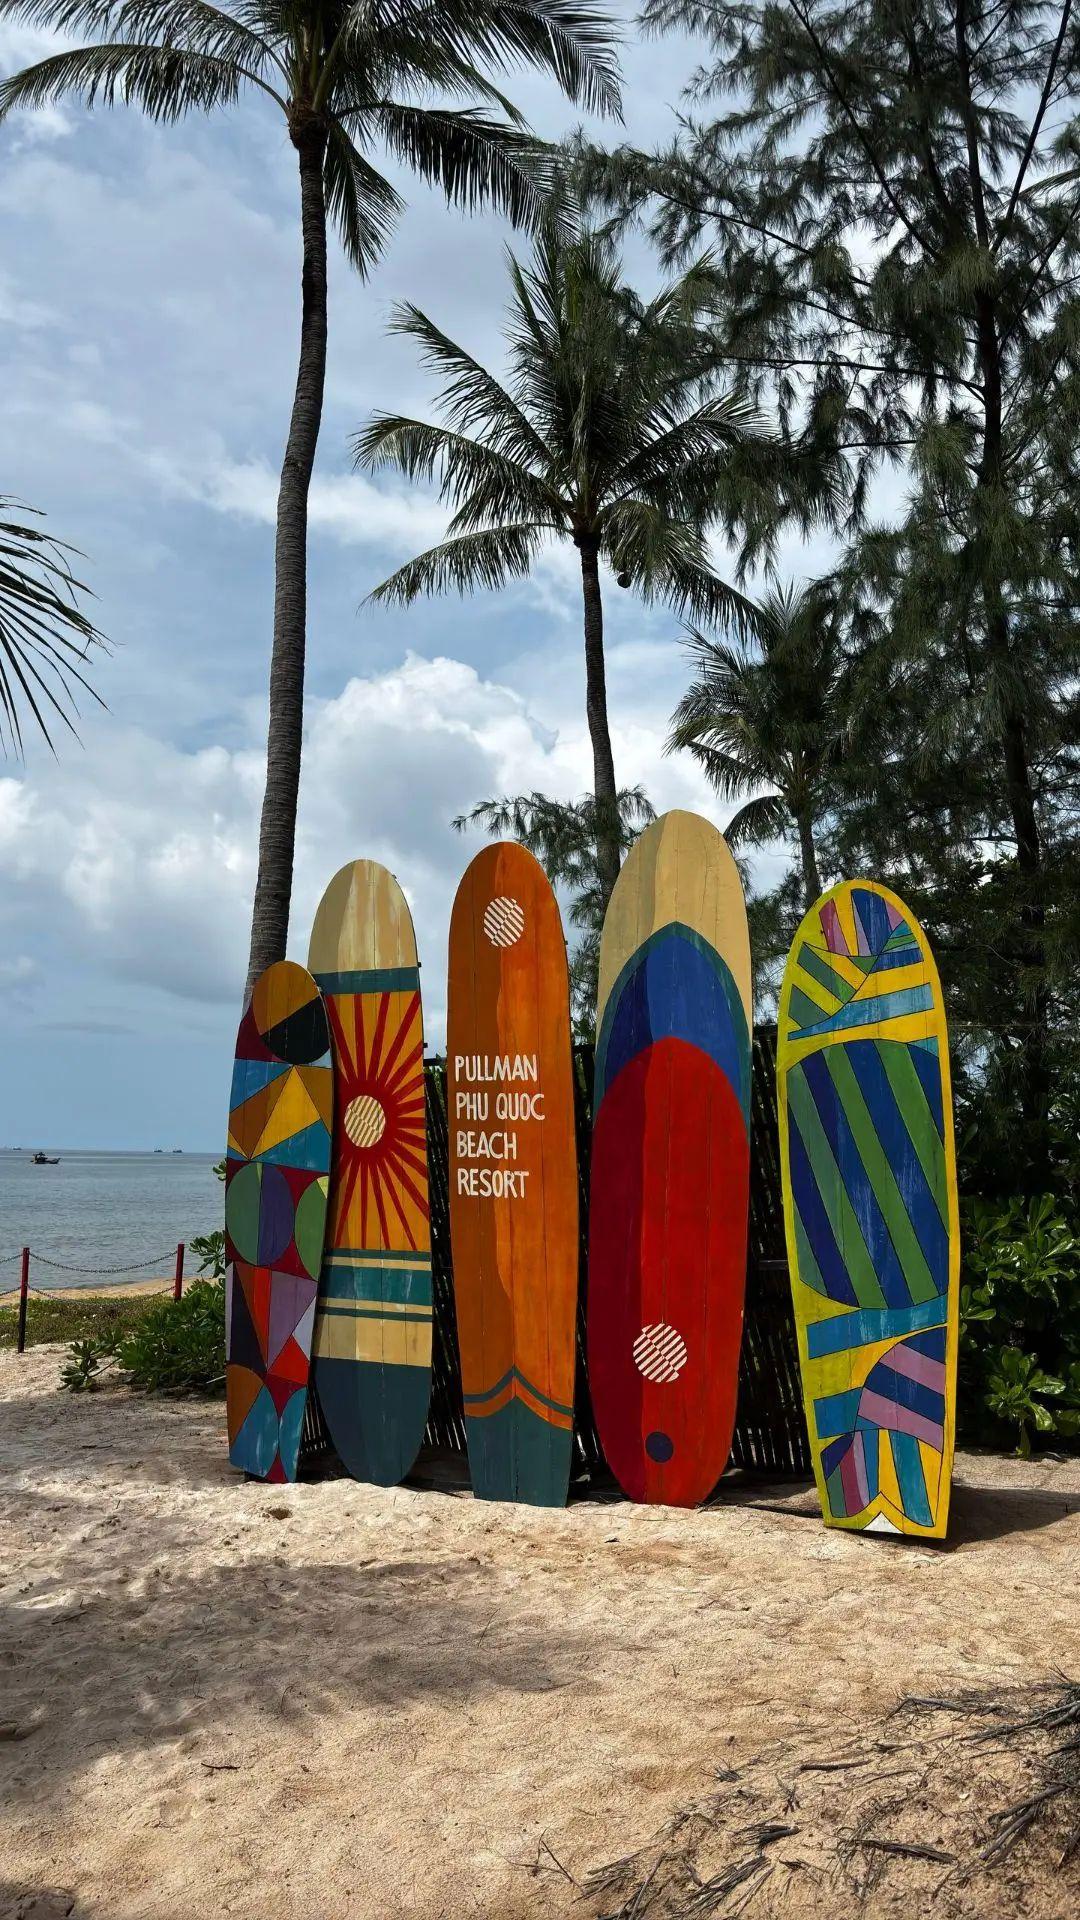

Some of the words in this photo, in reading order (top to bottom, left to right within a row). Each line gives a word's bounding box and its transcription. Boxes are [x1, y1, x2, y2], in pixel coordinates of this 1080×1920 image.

[454, 1055, 538, 1083] PULLMAN
[456, 1092, 489, 1121] PHU
[495, 1093, 546, 1121] QUOC
[457, 1131, 517, 1160] BEACH
[457, 1168, 530, 1198] RESORT
